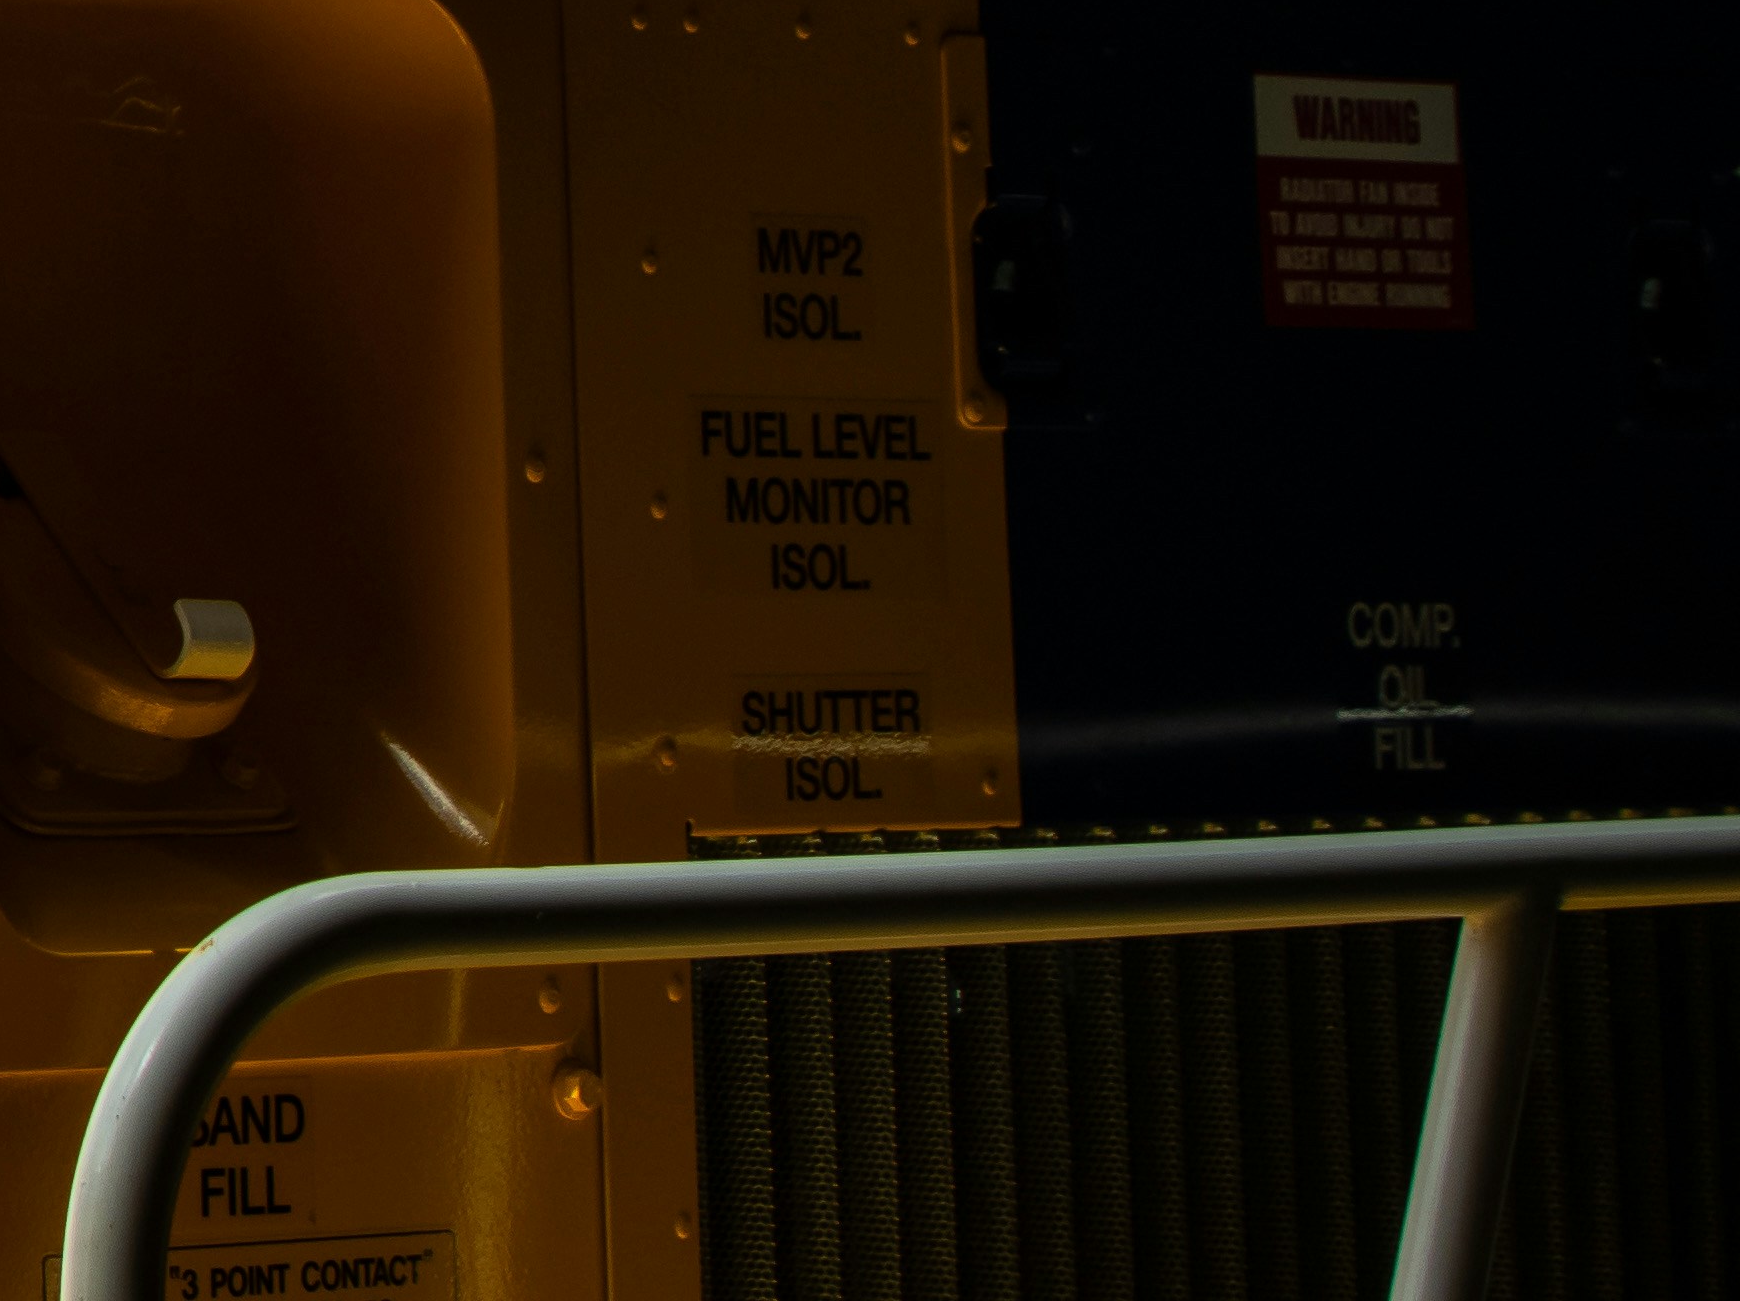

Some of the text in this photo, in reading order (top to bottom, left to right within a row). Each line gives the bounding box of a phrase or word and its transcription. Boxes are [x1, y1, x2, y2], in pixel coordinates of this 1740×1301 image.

[1292, 93, 1422, 146] WARNING
[756, 226, 864, 278] MVP2
[763, 292, 862, 341] ISOL.
[700, 410, 933, 461] FUEL LEVEL
[725, 476, 912, 526] MONITOR
[771, 543, 871, 591] ISOL.
[1347, 601, 1462, 648] COMP.
[740, 689, 921, 736] SHUTTER
[1375, 725, 1447, 770] FILL
[785, 755, 883, 801] ISOL.
[200, 1165, 293, 1218] FILL
[210, 1263, 289, 1299] POINT
